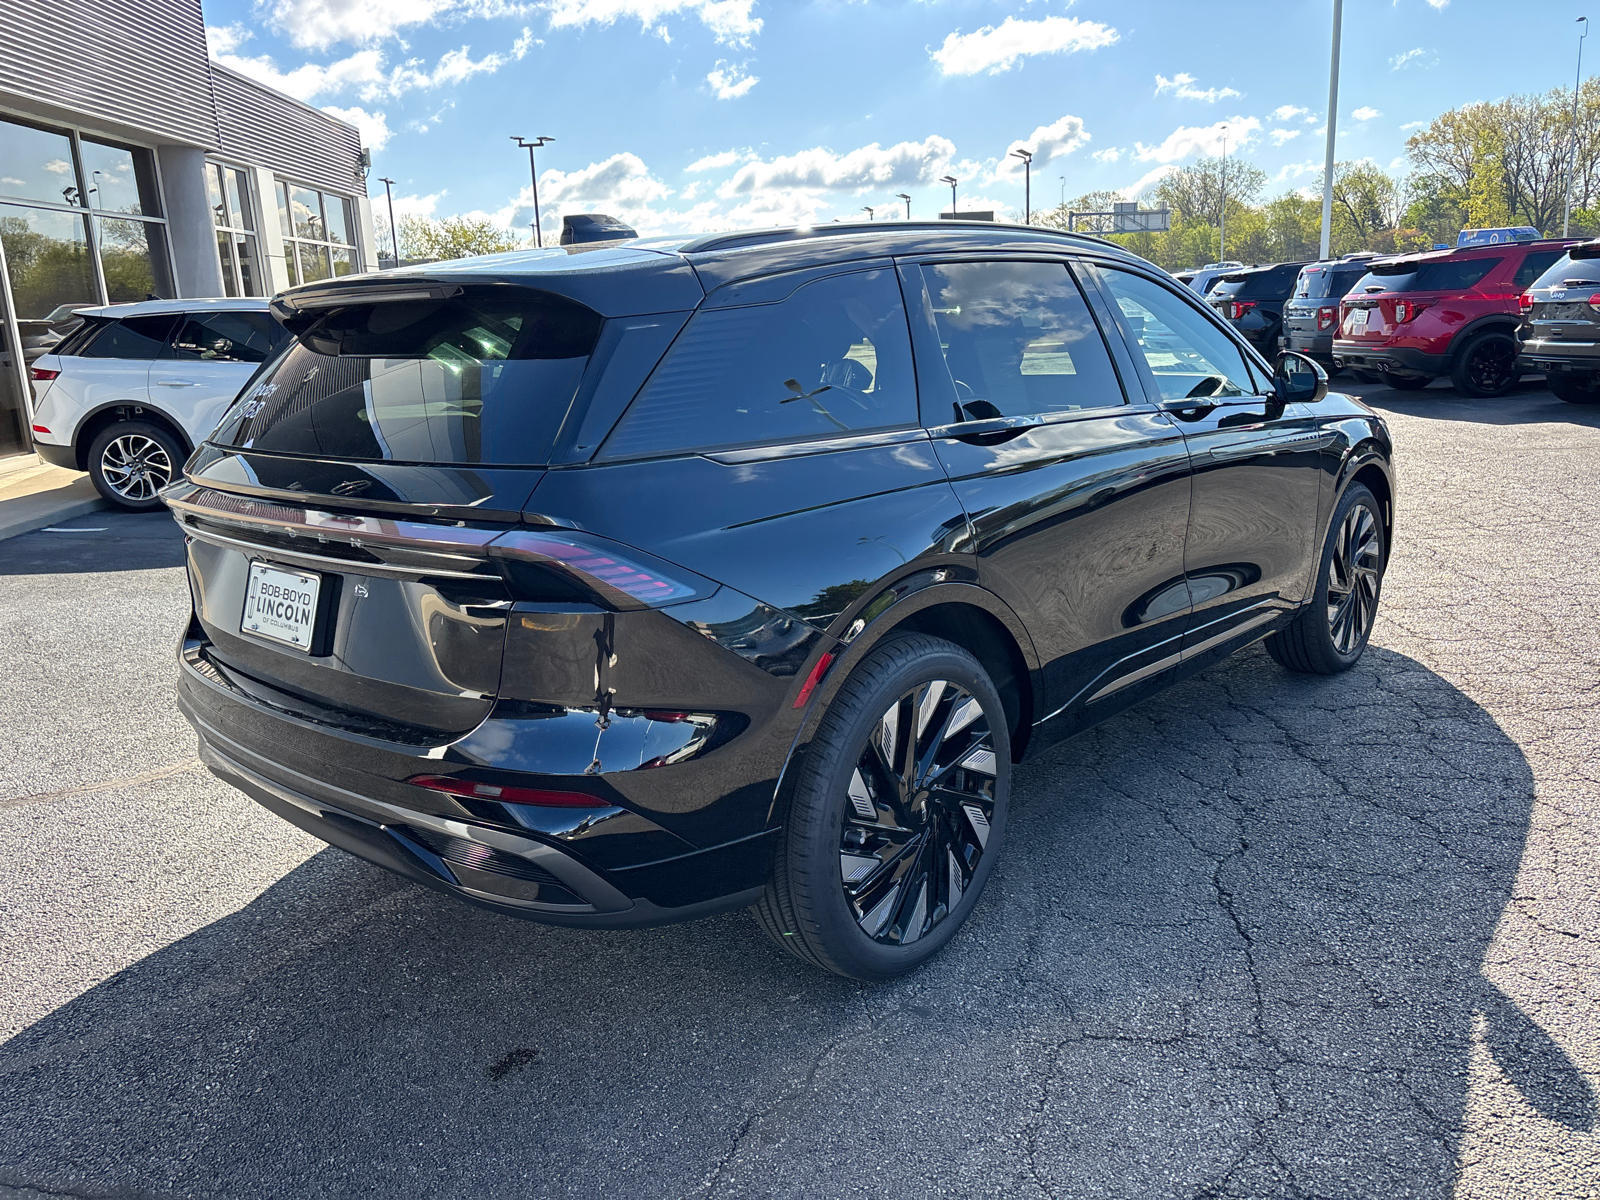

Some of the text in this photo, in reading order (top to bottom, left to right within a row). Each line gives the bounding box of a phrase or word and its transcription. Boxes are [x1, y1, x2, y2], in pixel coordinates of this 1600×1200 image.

[261, 583, 311, 606] BOB-BOYD
[257, 596, 311, 626] LINCOLN
[270, 619, 299, 632] COLUMBUS
